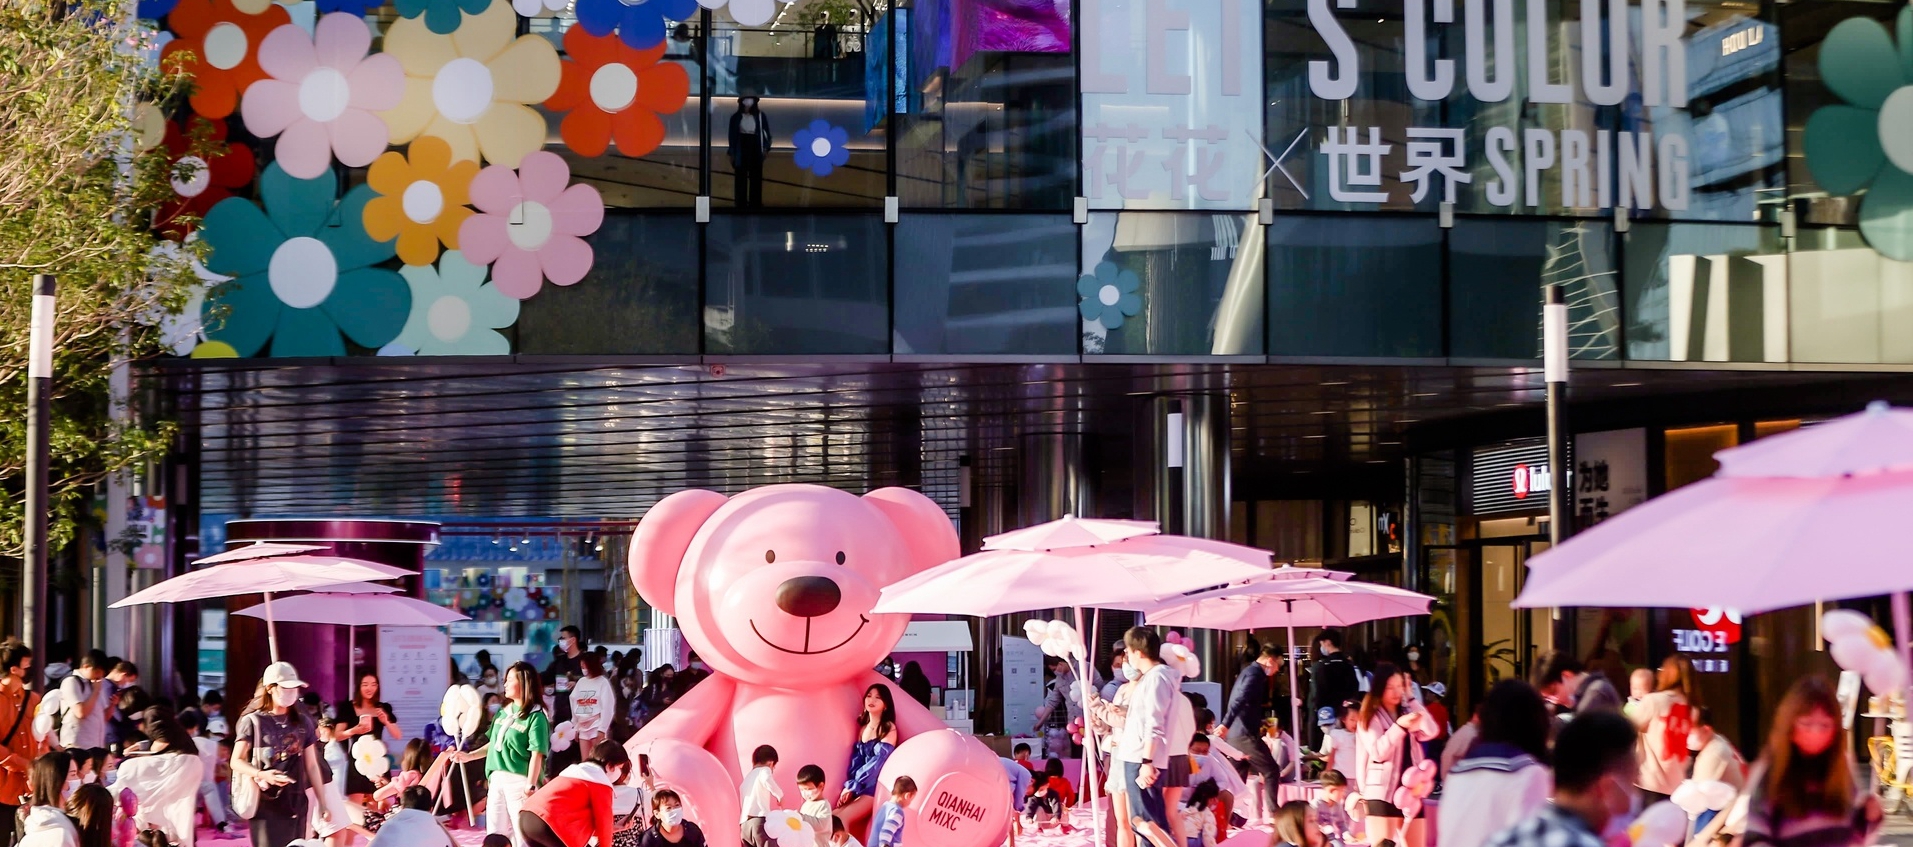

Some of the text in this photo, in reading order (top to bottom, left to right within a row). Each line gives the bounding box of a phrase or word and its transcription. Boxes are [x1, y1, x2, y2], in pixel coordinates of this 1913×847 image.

[1403, 0, 1688, 108] COLOR
[1082, 122, 1230, 201] 花花
[1484, 126, 1690, 211] SPRING
[928, 807, 960, 831] MIXC
[937, 791, 986, 823] QIANHAI
